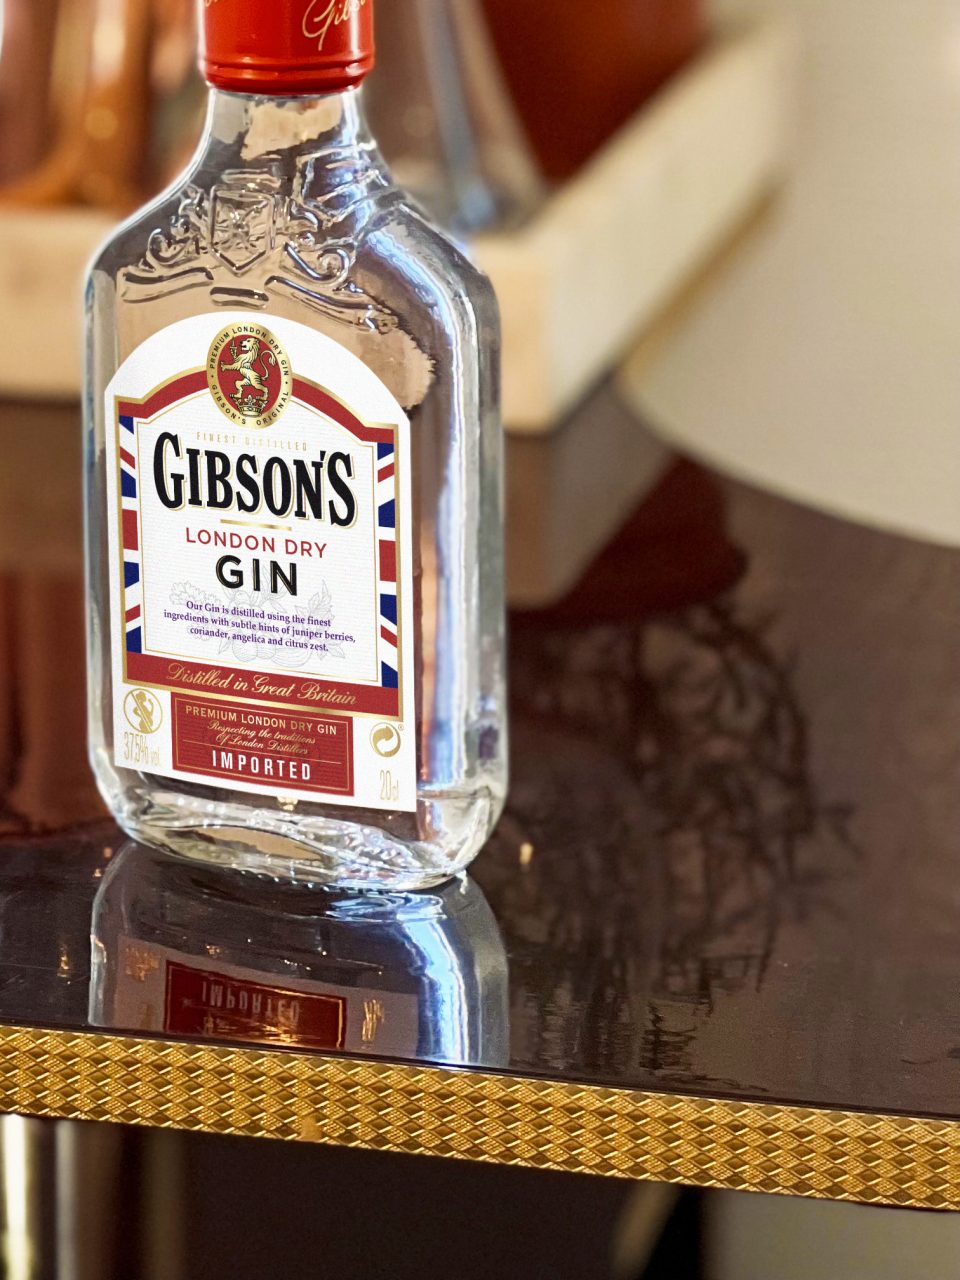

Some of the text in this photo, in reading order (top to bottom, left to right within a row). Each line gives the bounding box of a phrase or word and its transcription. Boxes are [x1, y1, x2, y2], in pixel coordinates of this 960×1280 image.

[210, 326, 289, 376] PREMIUM LONDON DRY GIN
[211, 384, 289, 426] GIBSON'S ORIGINAL
[153, 431, 358, 528] GIBSON'S
[186, 527, 327, 558] LONDON DRY
[215, 554, 297, 596] GIN
[163, 609, 356, 644] ingredients with subtle hints of juniper berries,
[186, 600, 332, 627] Our Gin is distilled using the finest
[190, 626, 329, 652] coriander, angelica and citrus zest.
[167, 662, 357, 705] Distilled in Great Britain
[185, 705, 337, 735] PREMIUM LONDON DRY GIN
[207, 720, 316, 745] Respecting the traditions
[215, 732, 309, 755] Of London Distillers
[212, 749, 311, 780] IMPORTED
